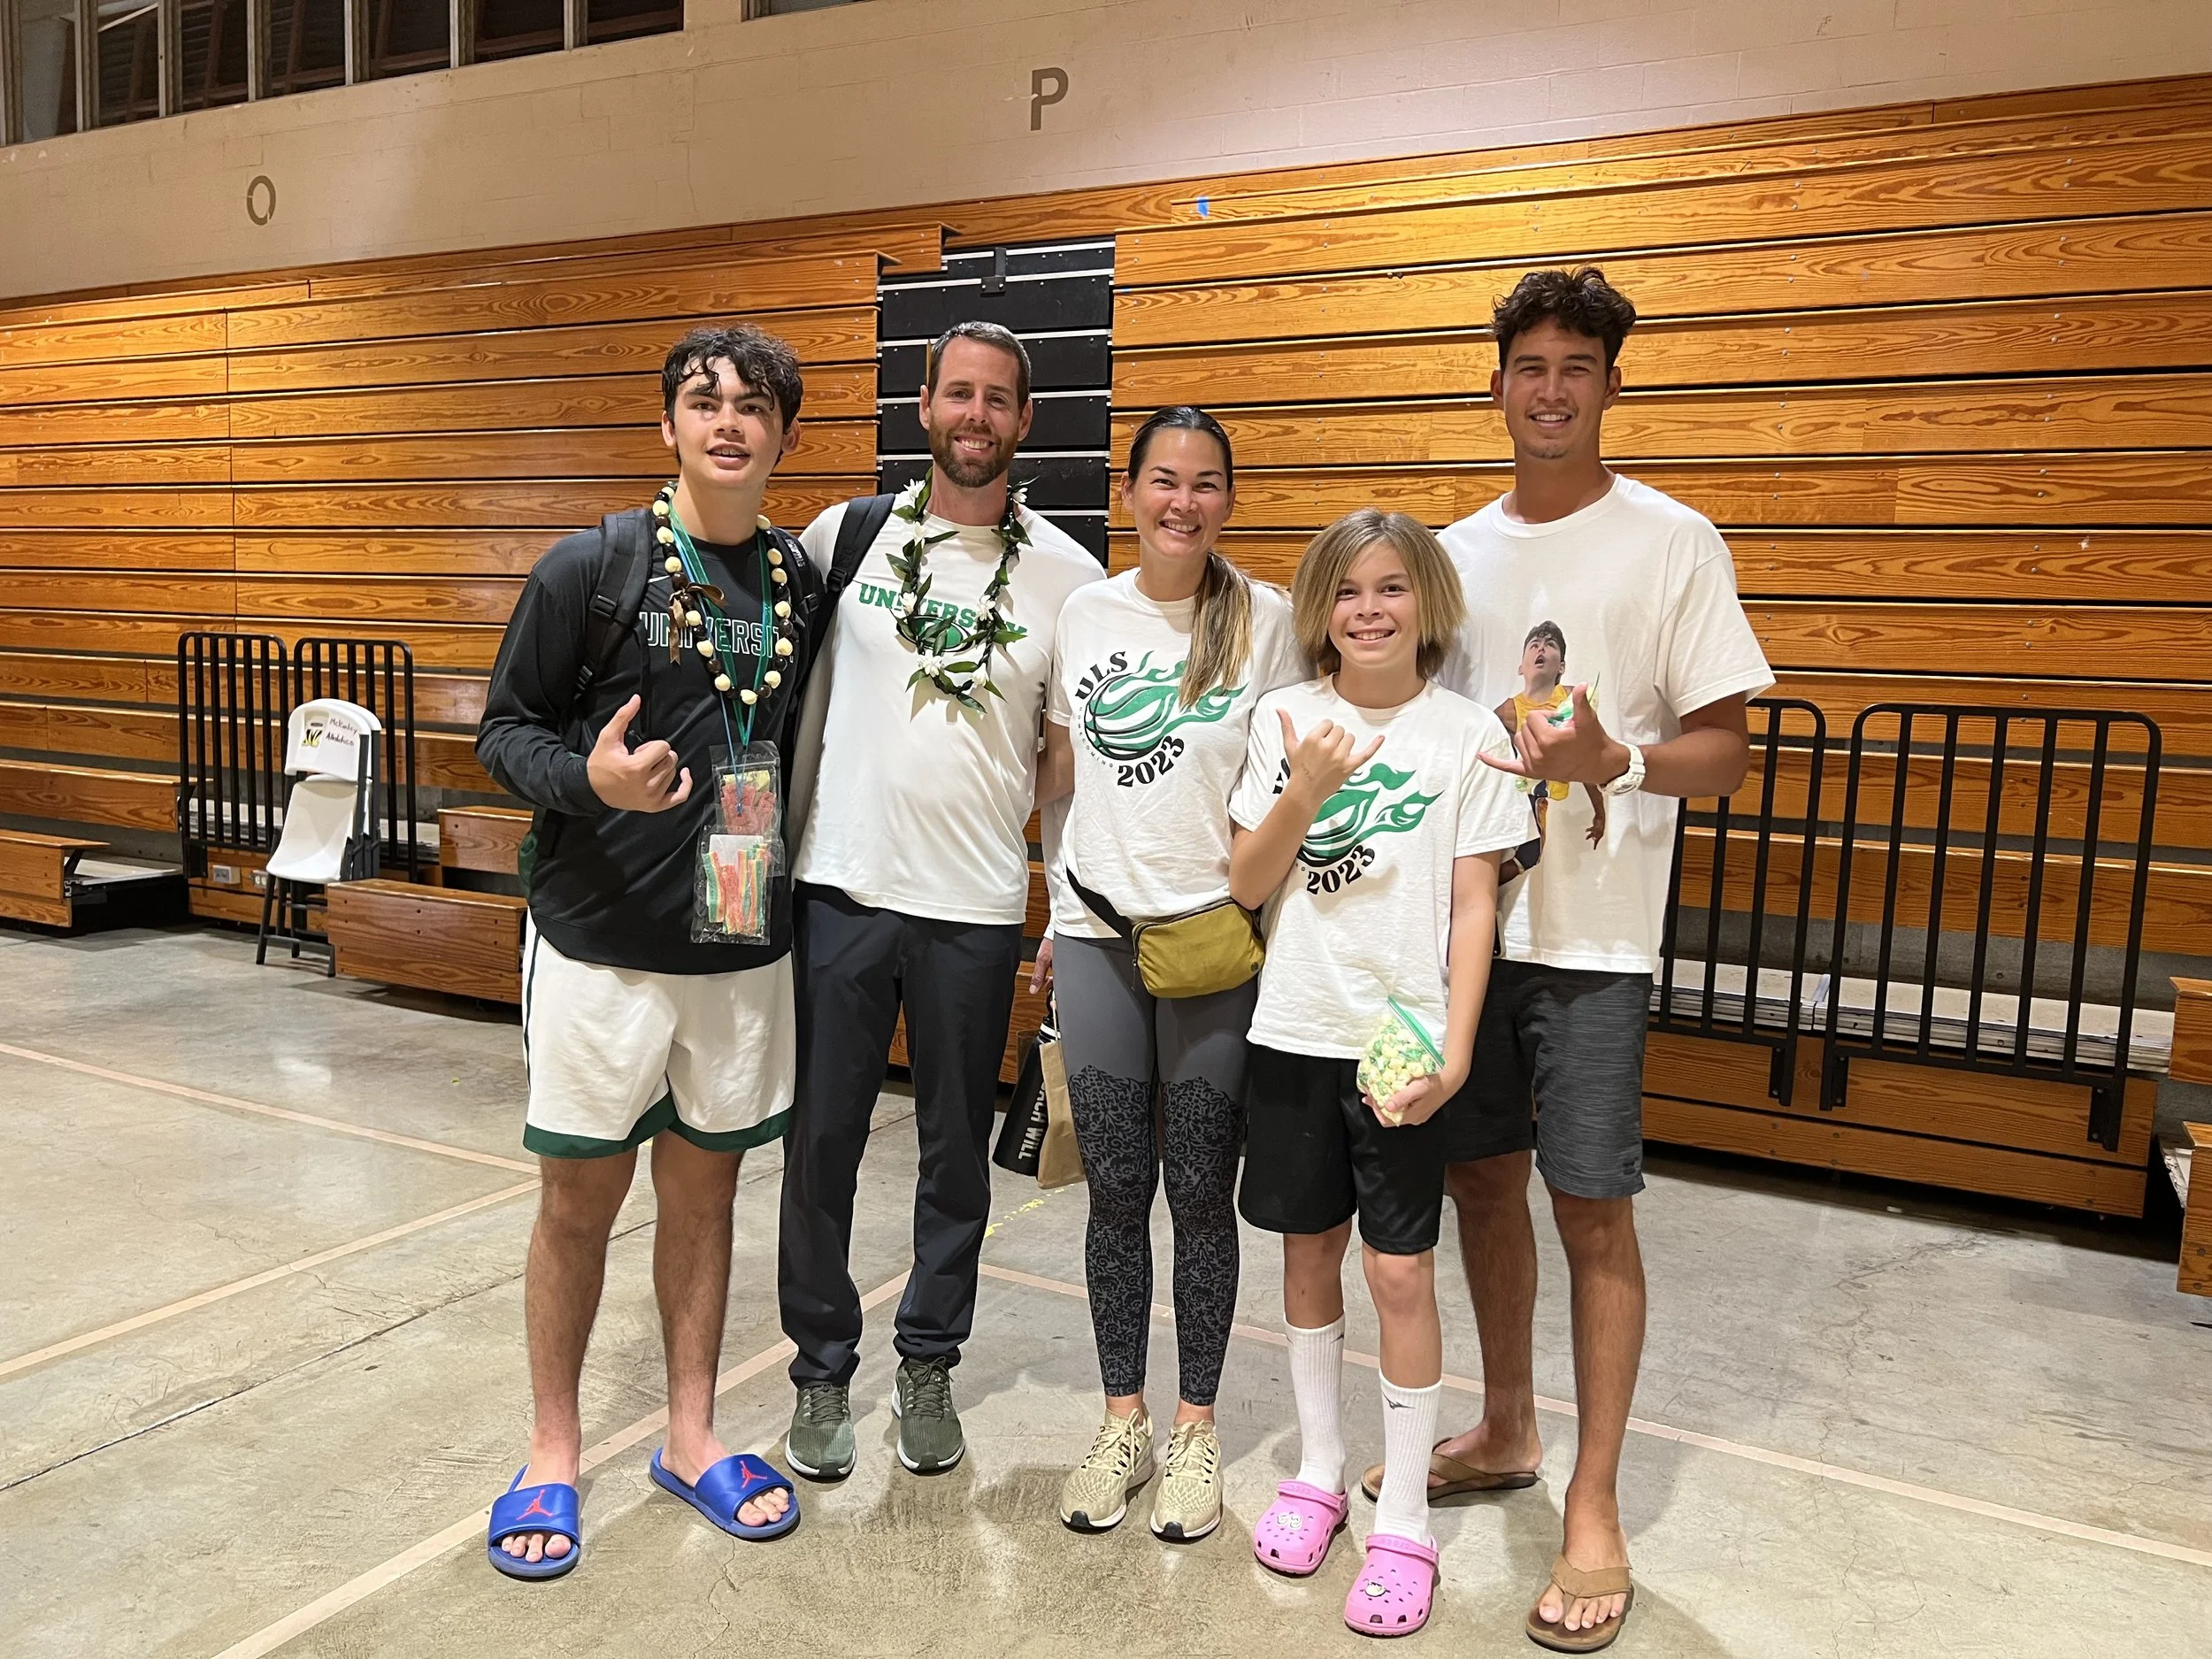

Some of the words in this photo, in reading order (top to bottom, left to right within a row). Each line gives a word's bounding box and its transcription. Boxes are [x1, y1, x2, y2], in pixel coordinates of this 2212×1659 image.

[1031, 67, 1069, 131] P
[246, 175, 276, 226] O
[1075, 650, 1128, 700] ULS
[1117, 735, 1185, 787] 2023
[1307, 844, 1376, 895] 2023
[1018, 1126, 1044, 1160] WILL
